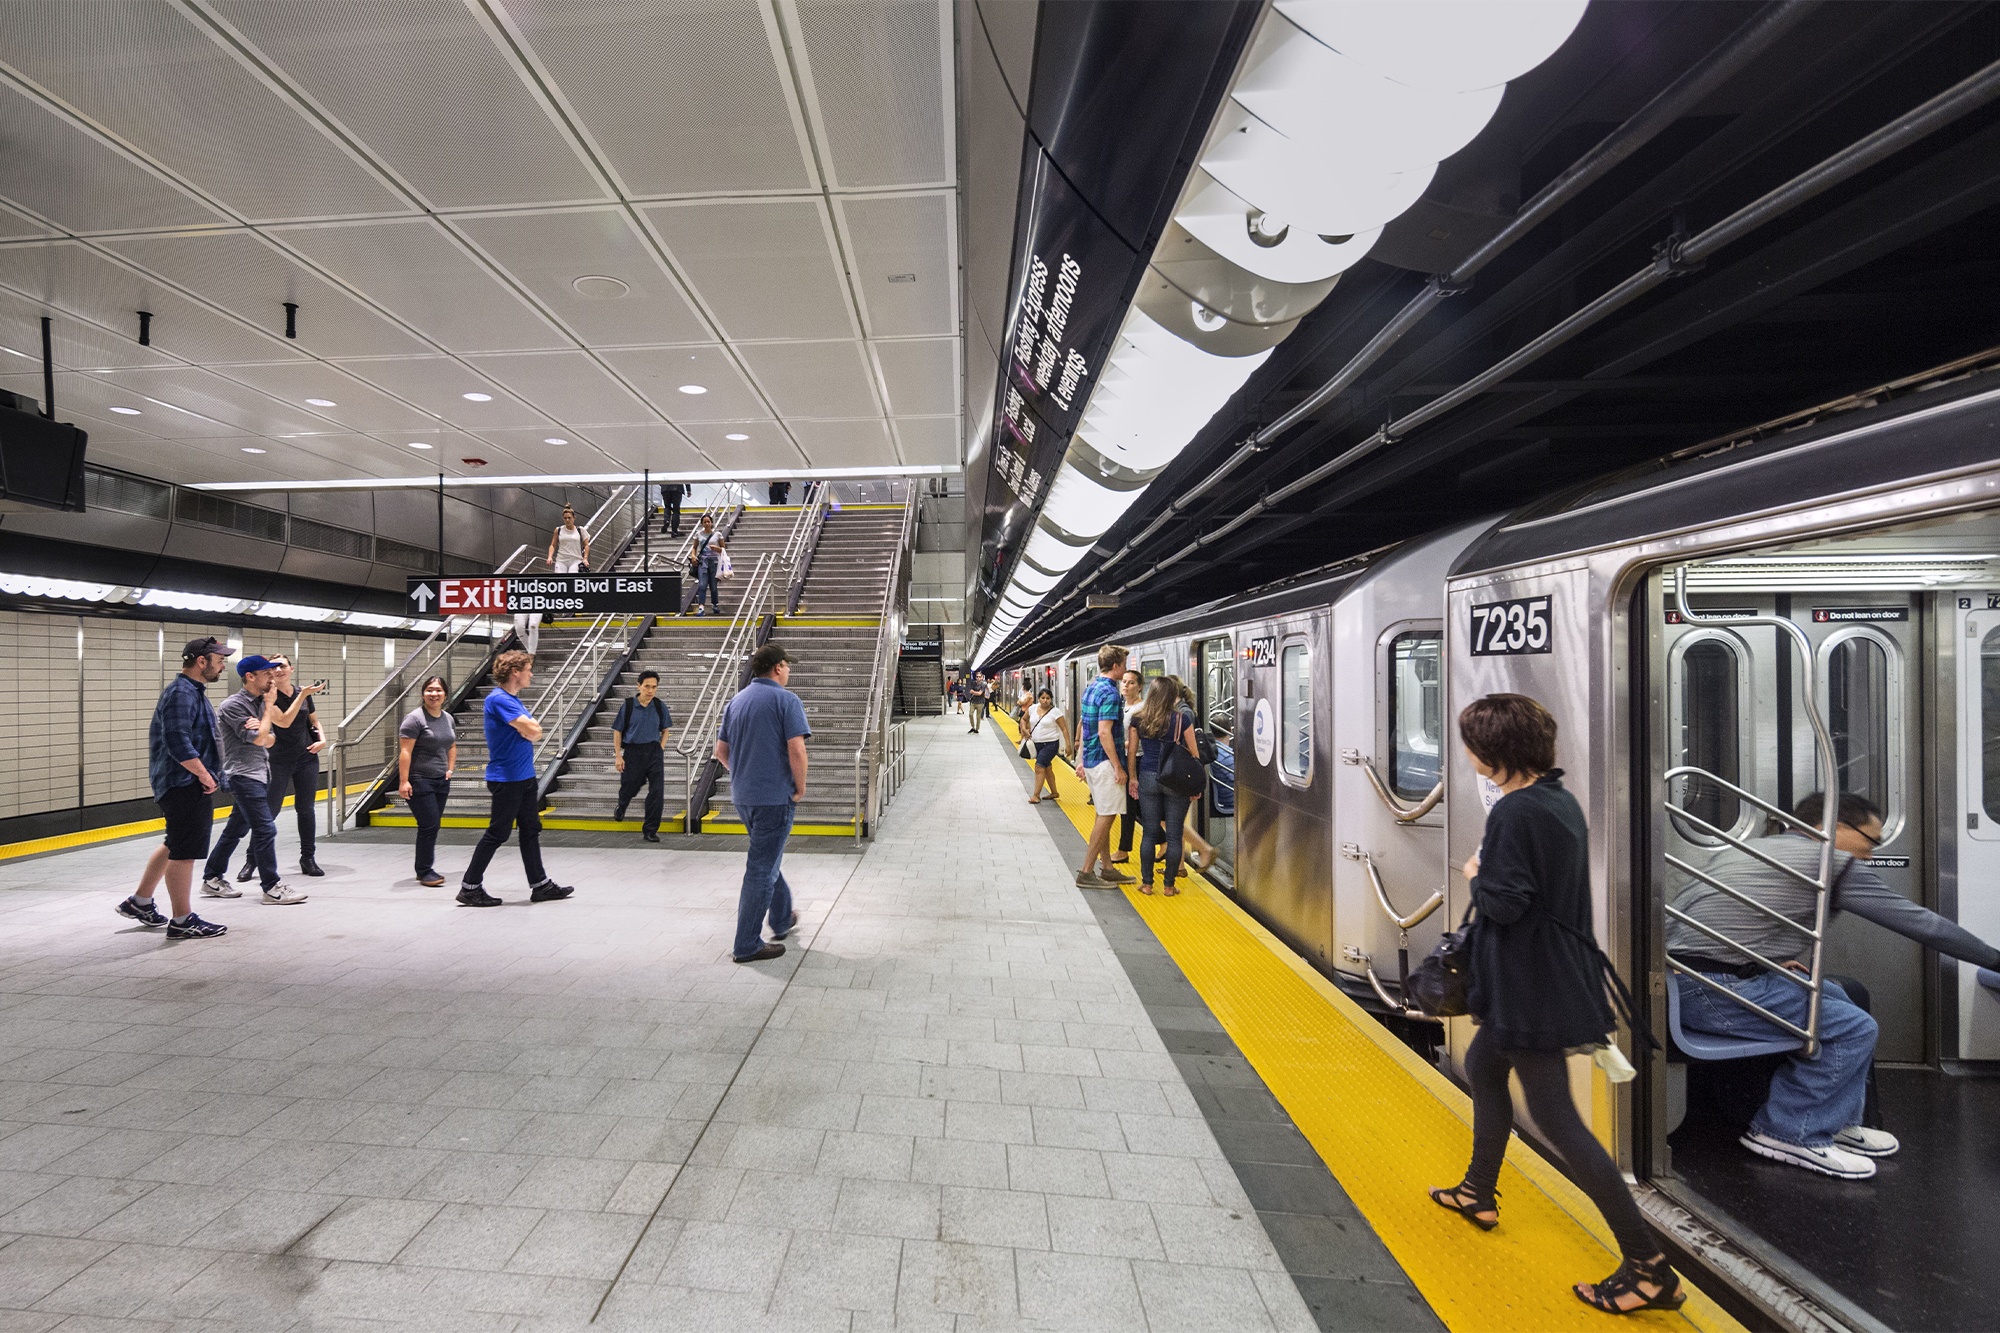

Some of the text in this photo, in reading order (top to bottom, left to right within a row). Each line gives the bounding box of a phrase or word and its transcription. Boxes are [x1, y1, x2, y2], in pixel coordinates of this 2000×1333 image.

[1014, 254, 1049, 370] Flushing Express
[1035, 253, 1082, 391] weekday afternoons
[1050, 347, 1088, 412] & evenings
[1019, 411, 1036, 443] Local
[440, 579, 505, 609] Exit
[507, 577, 653, 594] Hudson Blvd East
[507, 595, 584, 610] & Buses
[1855, 611, 1870, 619] lean
[1882, 611, 1900, 619] door
[1961, 599, 1969, 609] 2
[1473, 600, 1548, 652] 7235
[1252, 638, 1276, 665] 7234
[1886, 859, 1905, 867] door
